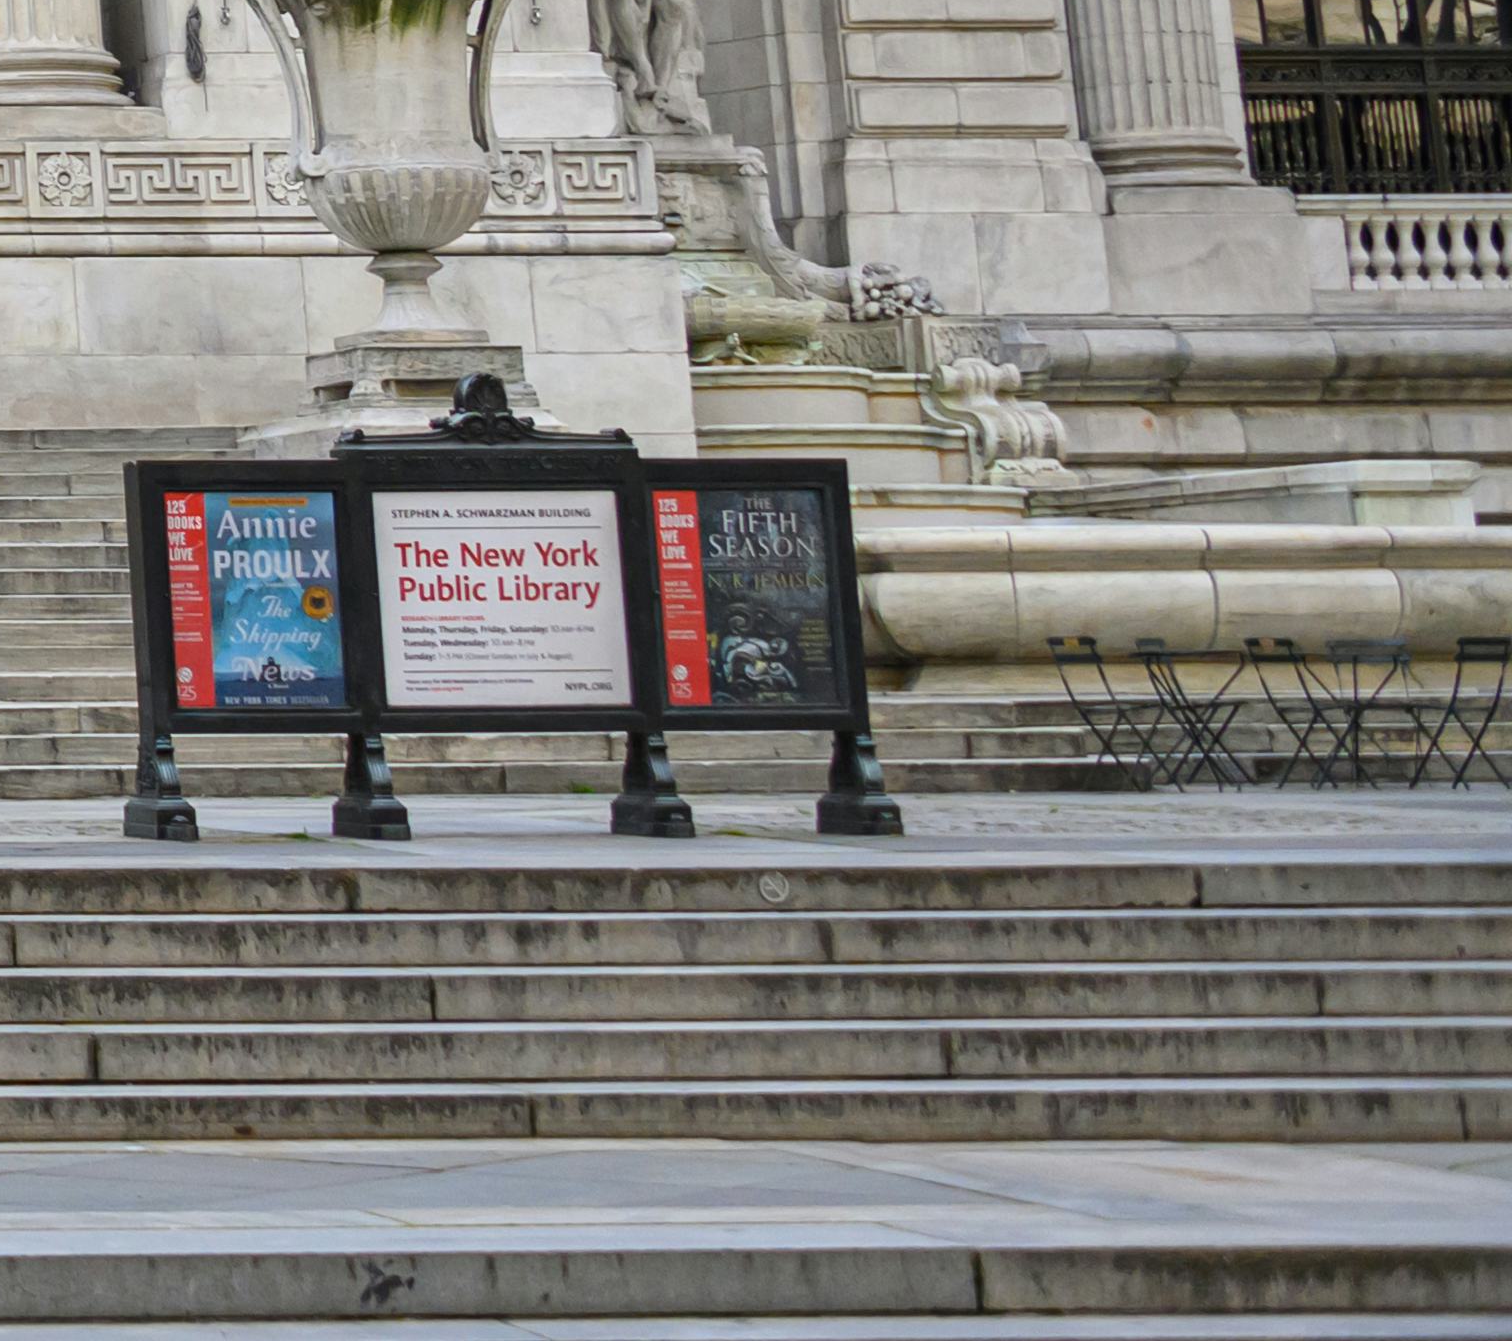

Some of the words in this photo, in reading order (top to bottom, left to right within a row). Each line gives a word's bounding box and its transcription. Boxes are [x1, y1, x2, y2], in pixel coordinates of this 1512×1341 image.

[167, 500, 185, 514] 125
[658, 499, 678, 513] 125
[744, 497, 773, 510] THE
[391, 509, 439, 519] STEPHEN
[442, 509, 453, 518] A.
[456, 509, 535, 518] SCHWARZMAN
[538, 508, 591, 518] BUILDING
[167, 516, 202, 529] BOOKS
[217, 509, 317, 539] Annie
[660, 514, 694, 528] BOOKS
[722, 510, 797, 534] FIFTH
[168, 532, 186, 546] WE
[660, 530, 679, 544] WE
[662, 545, 687, 560] LOVE
[709, 534, 816, 558] SEASON
[169, 548, 194, 562] LOVE
[394, 541, 449, 568] The
[460, 542, 525, 568] New
[534, 540, 599, 567] York
[214, 550, 331, 579] PROULX
[398, 575, 487, 602] Public
[497, 574, 600, 609] Library
[257, 595, 292, 618] The
[230, 619, 321, 651] Shipping
[231, 656, 316, 682] News
[565, 682, 613, 691] NYPL.ORG
